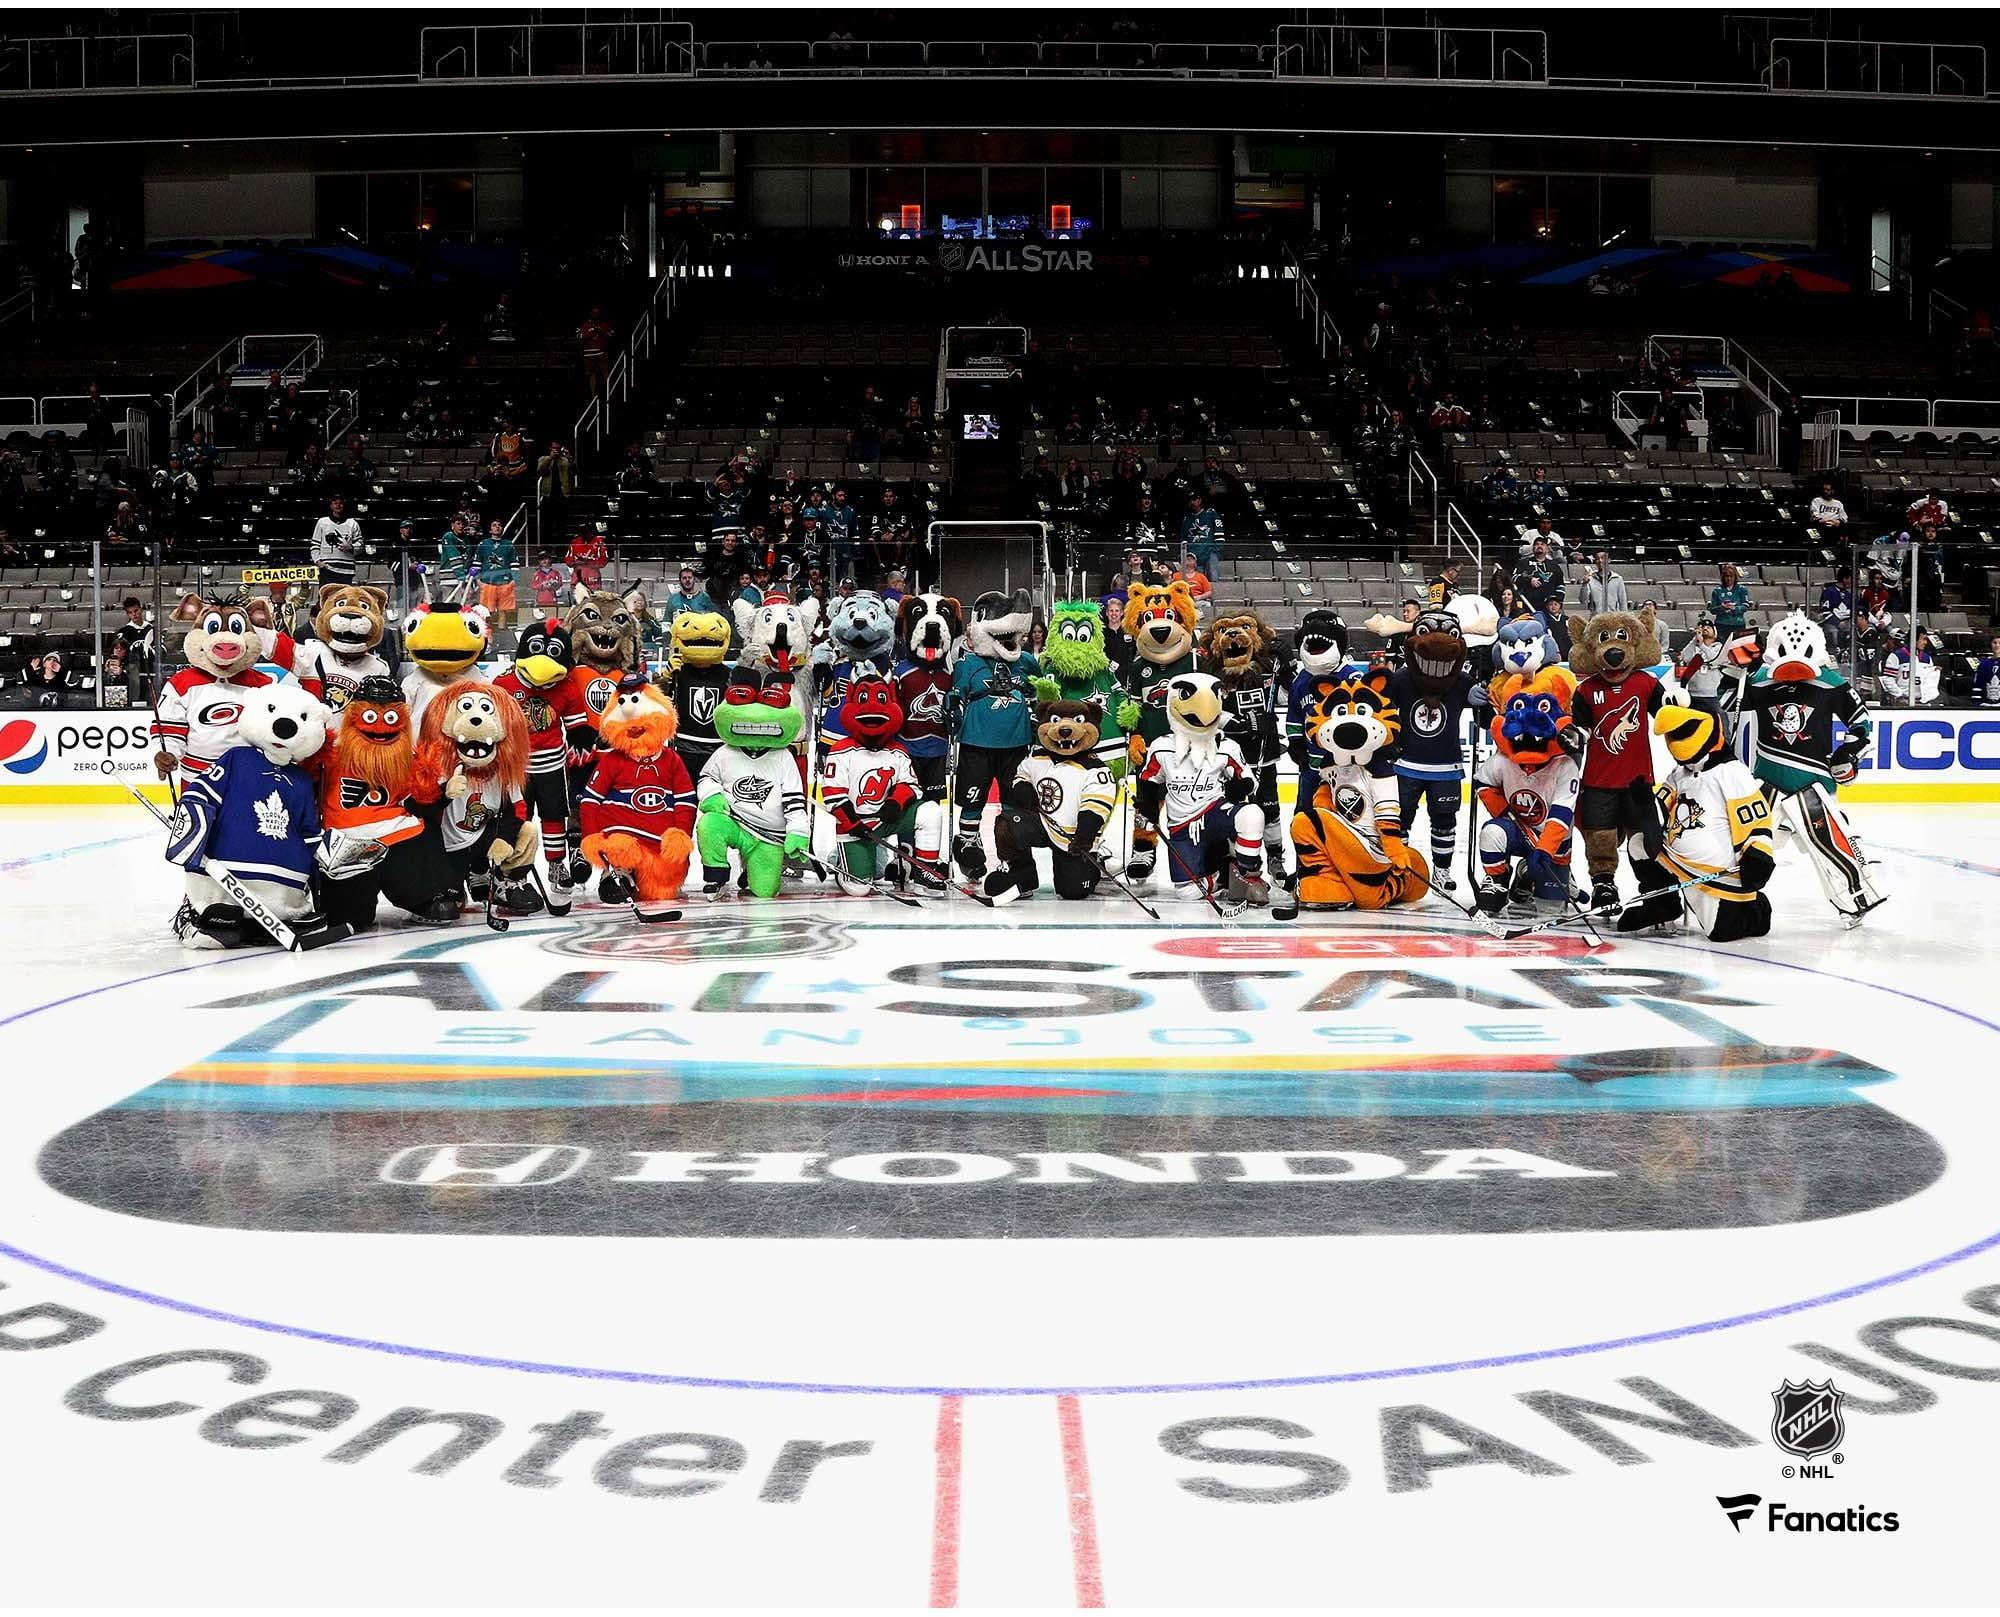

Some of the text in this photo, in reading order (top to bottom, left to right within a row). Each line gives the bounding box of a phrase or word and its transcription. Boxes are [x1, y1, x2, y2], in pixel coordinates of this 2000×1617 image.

[254, 568, 306, 582] CHANCE!
[1239, 691, 1263, 705] LA
[1593, 692, 1604, 705] M
[73, 762, 148, 771] ZERO SUGAR
[1736, 800, 1768, 825] 00
[1848, 836, 1868, 868] Reebok
[221, 873, 287, 938] Reebok
[436, 1025, 1563, 1048] SAN JOSE
[611, 1148, 1617, 1185] HONDA
[62, 1348, 874, 1504] Center
[1156, 1375, 1762, 1505] SAN
